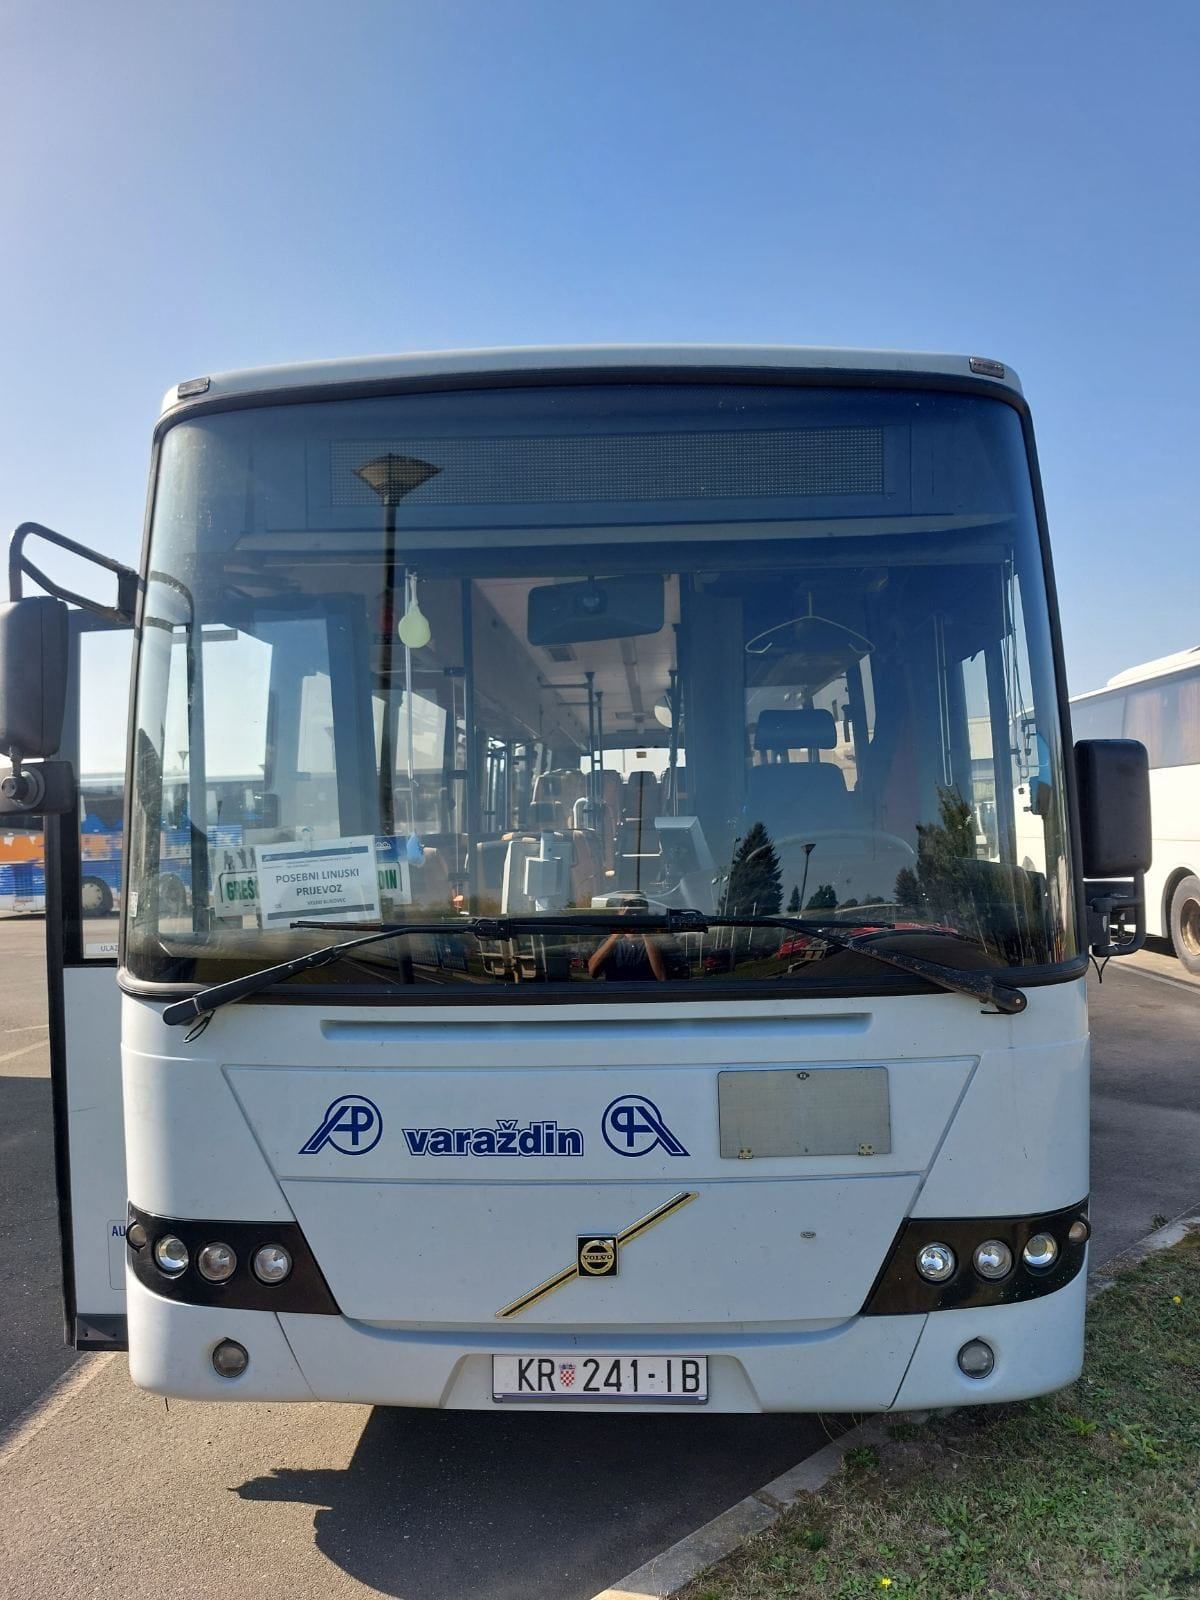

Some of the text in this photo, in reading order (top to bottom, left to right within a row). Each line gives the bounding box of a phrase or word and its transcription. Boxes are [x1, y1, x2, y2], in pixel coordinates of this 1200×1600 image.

[275, 868, 360, 884] POSEBNI LINIJSKI
[296, 884, 343, 896] PRIJEVOZ
[402, 1119, 584, 1157] varaždin
[517, 1358, 700, 1393] KR 241-IB
